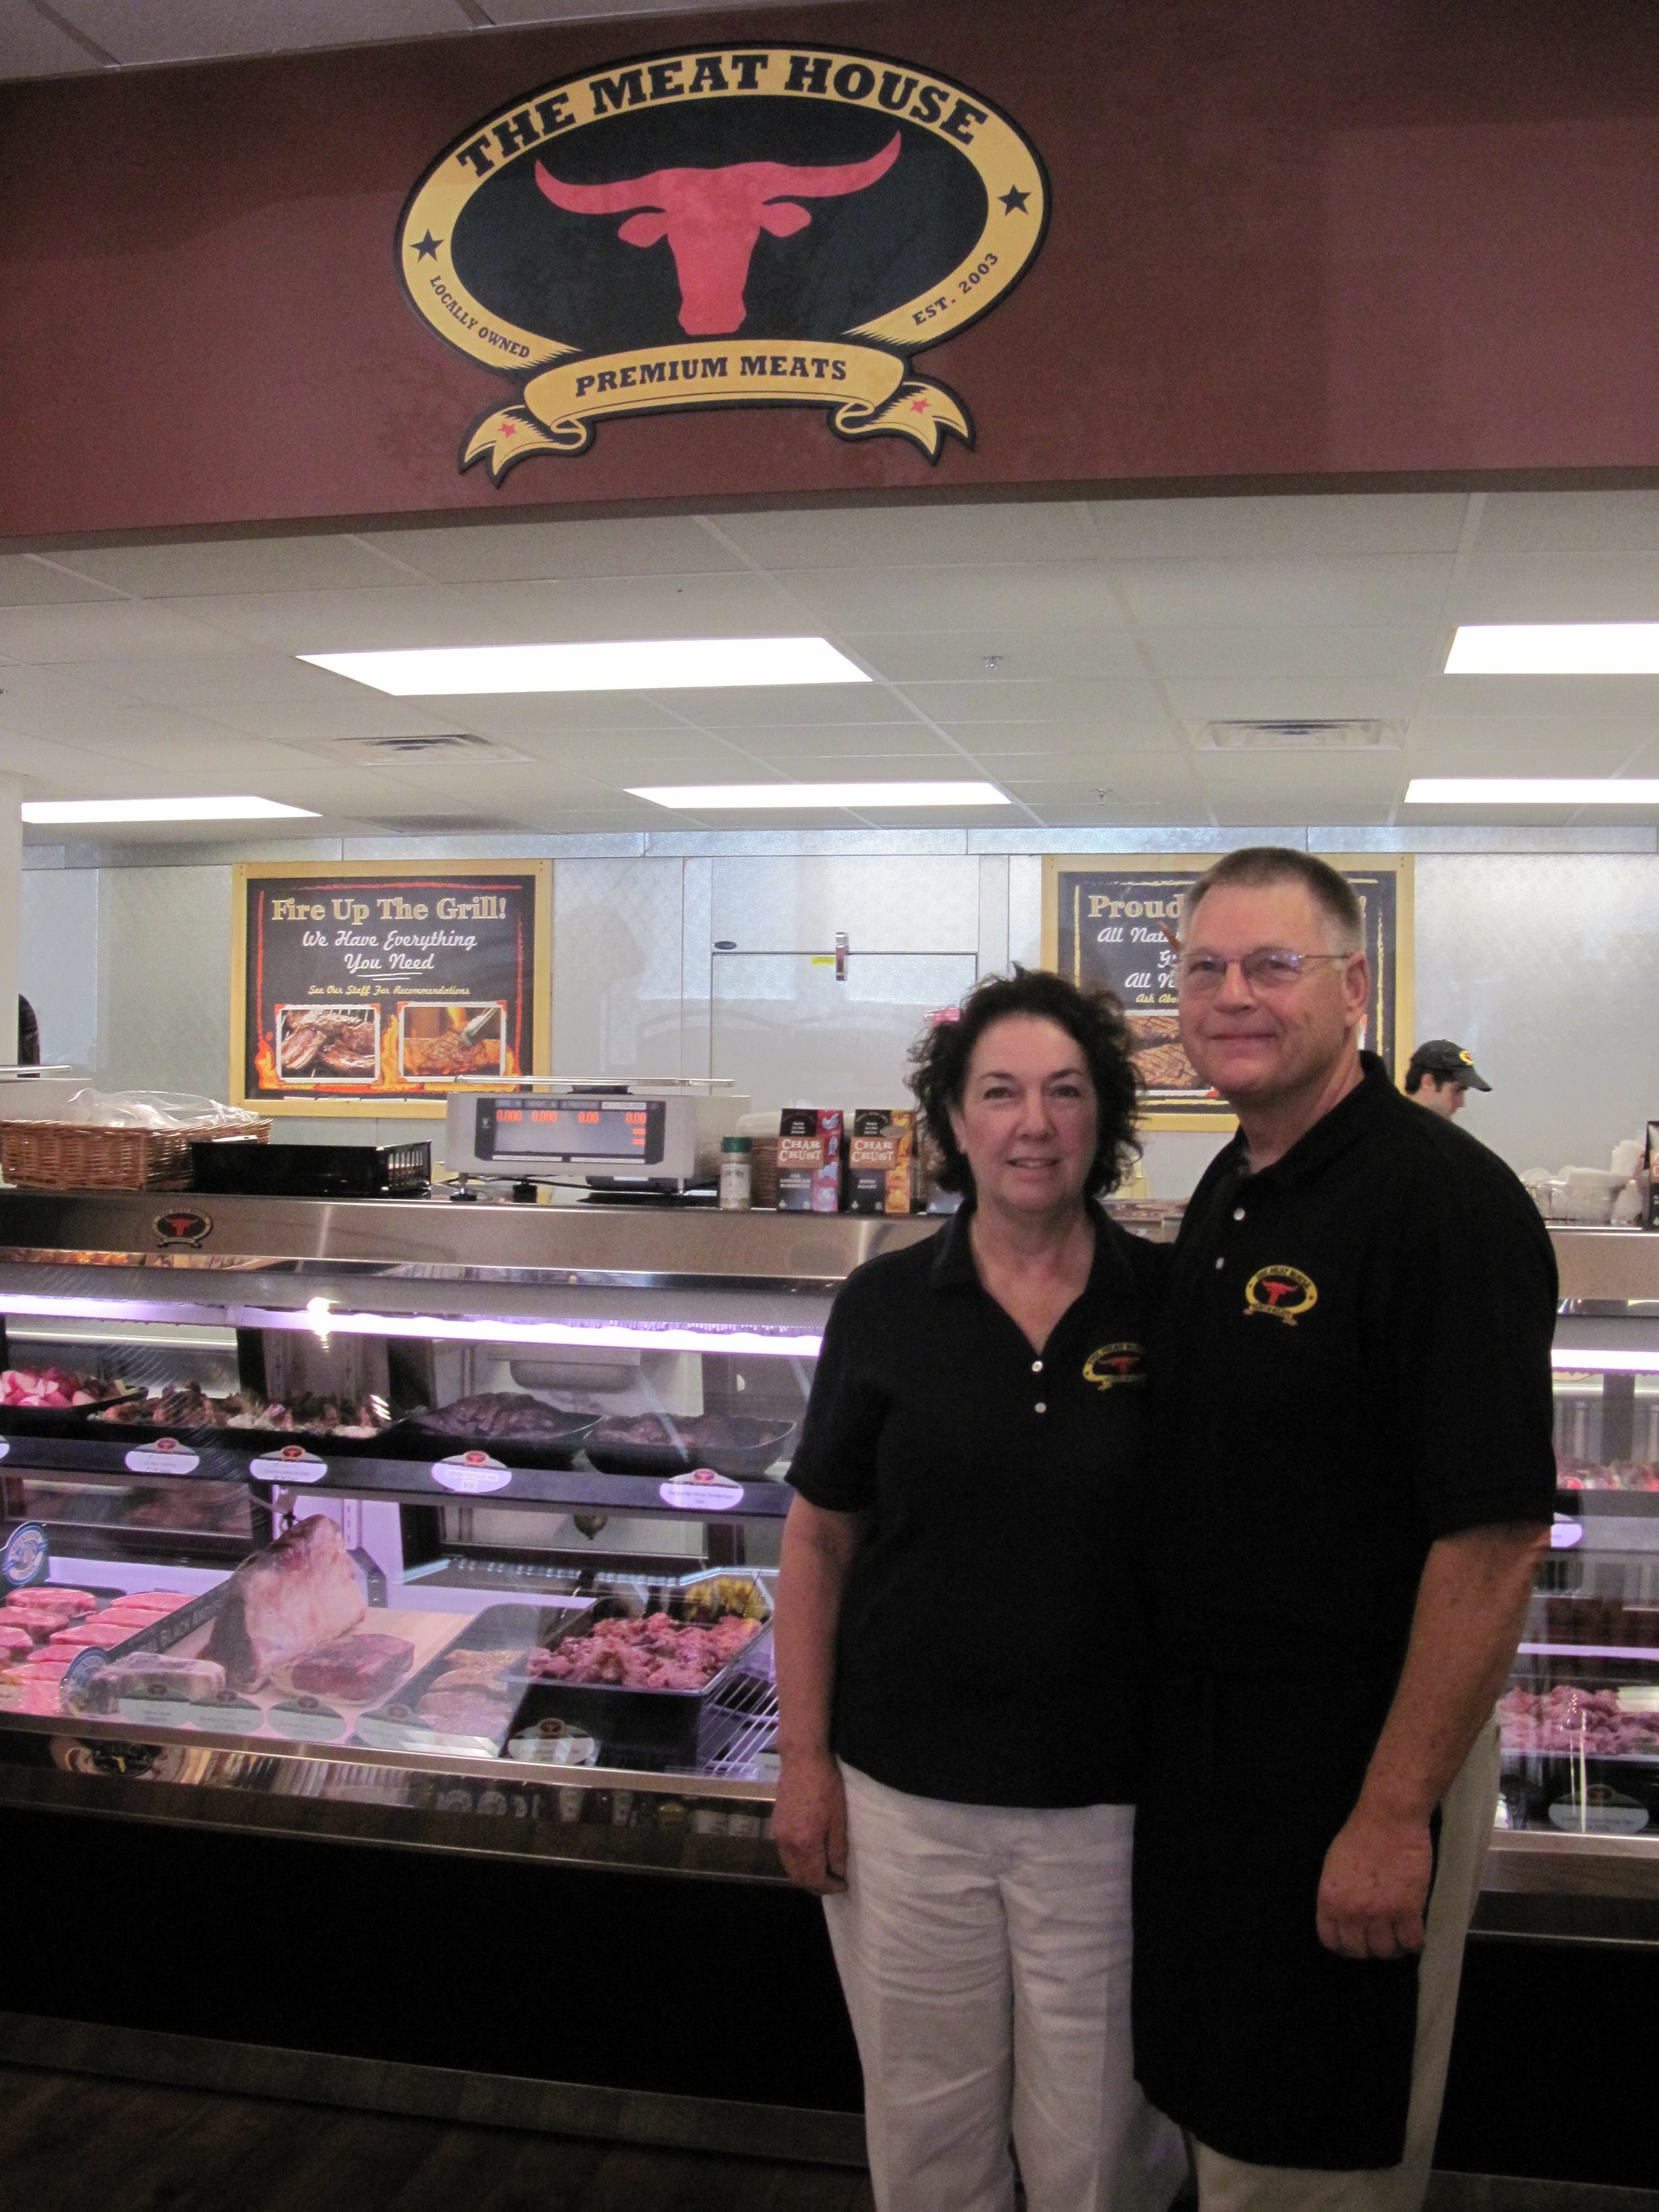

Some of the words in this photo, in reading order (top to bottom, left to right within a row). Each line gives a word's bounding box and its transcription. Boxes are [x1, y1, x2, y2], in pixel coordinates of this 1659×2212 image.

[456, 92, 575, 177] THE
[589, 54, 768, 115] MEAT
[784, 55, 988, 145] HOUSE
[912, 296, 956, 325] EST.
[958, 253, 998, 294] 2003
[430, 275, 478, 330] LOCALLY
[478, 327, 530, 358] OWNED
[576, 357, 728, 398] PREMIUM
[740, 356, 848, 382] MEATS
[272, 898, 326, 921] Fire
[332, 899, 369, 925] Up
[377, 897, 429, 920] The
[436, 895, 506, 919] Grill!
[302, 931, 328, 947] We
[335, 931, 379, 947] Have
[383, 930, 477, 951] Everything
[1097, 927, 1124, 942] All
[344, 953, 382, 974] You
[389, 953, 435, 970] Need
[307, 985, 325, 995] See
[326, 985, 343, 994] Our
[345, 985, 371, 996] Staff
[373, 985, 390, 995] For
[393, 985, 470, 995] Recommendations
[1124, 973, 1151, 988] All
[1135, 993, 1155, 1003] Ask
